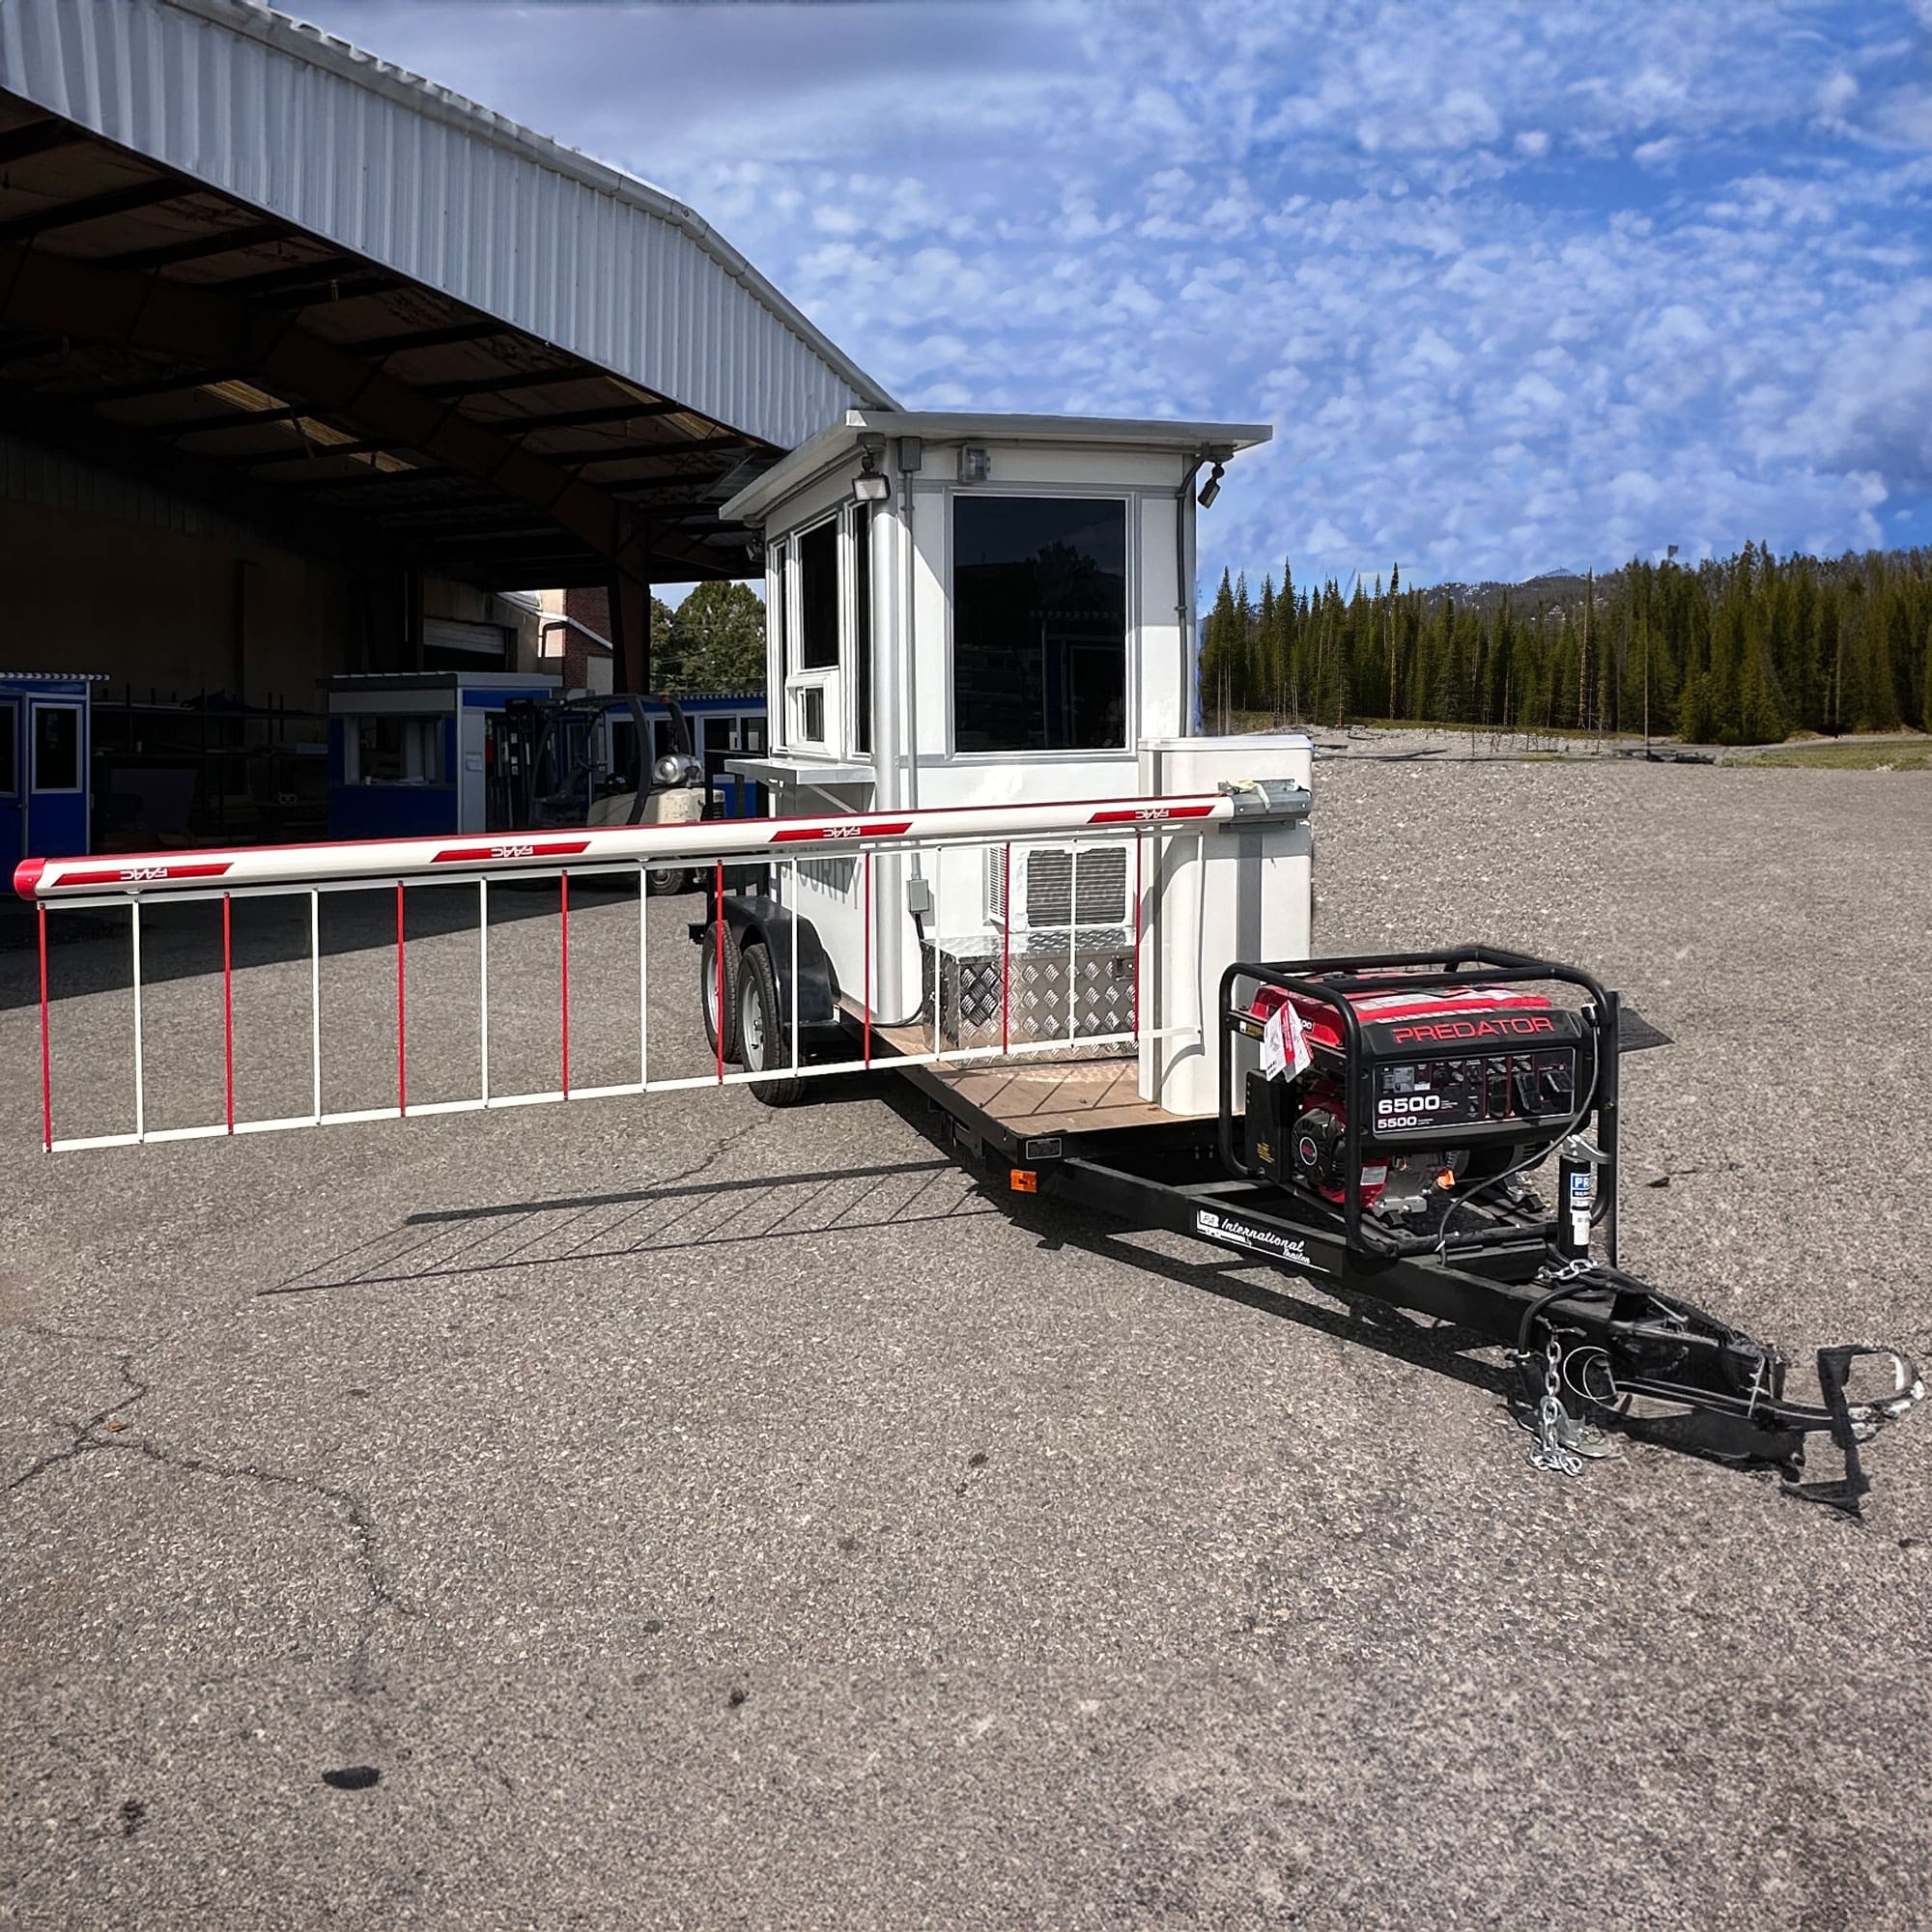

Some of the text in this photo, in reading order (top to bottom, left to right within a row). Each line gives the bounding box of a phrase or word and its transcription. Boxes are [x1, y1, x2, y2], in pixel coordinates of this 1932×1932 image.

[1135, 809, 1169, 819] FAAC
[822, 826, 861, 838] FAAC
[491, 845, 534, 858] FAAC
[120, 867, 168, 880] FAAC
[780, 847, 863, 910] SCURITY
[1392, 1017, 1555, 1044] PREDATOR
[1378, 1094, 1440, 1115] 6500
[1378, 1116, 1417, 1129] 5500
[1221, 1217, 1305, 1252] International
